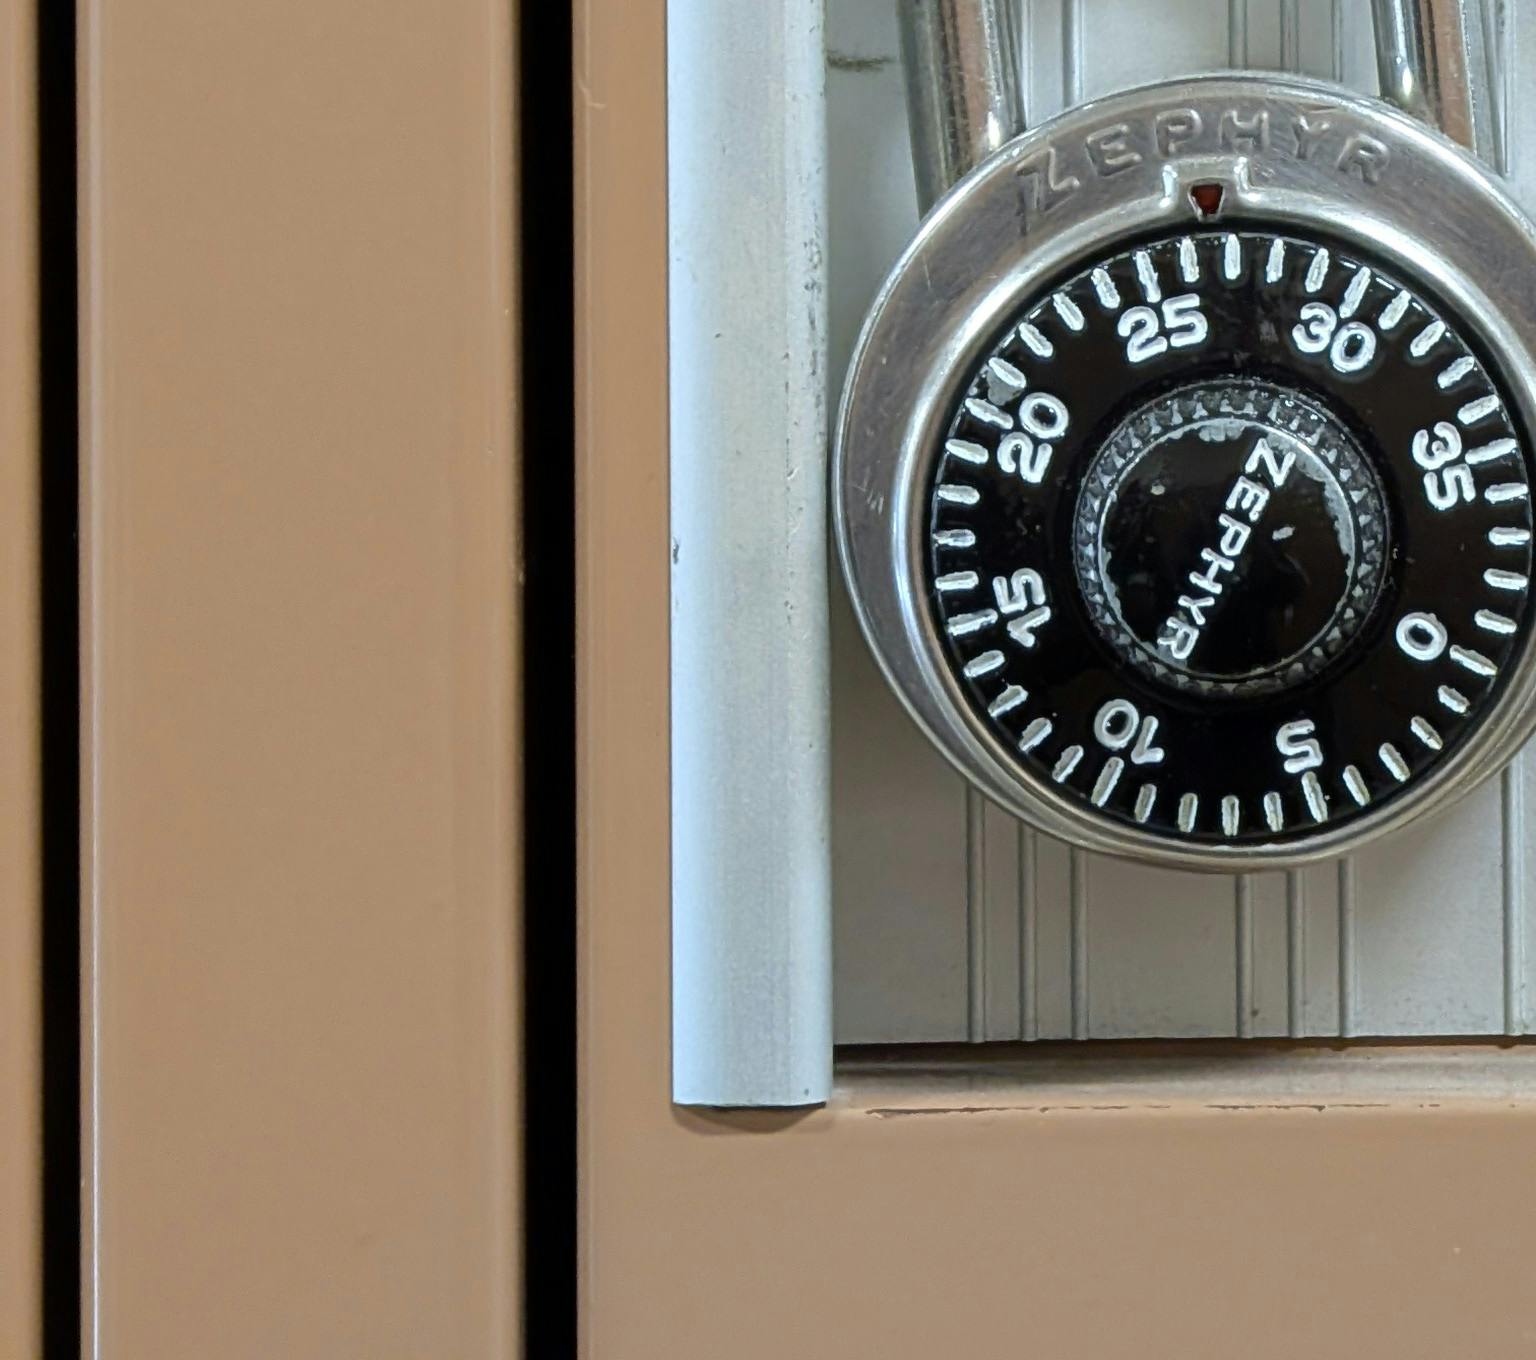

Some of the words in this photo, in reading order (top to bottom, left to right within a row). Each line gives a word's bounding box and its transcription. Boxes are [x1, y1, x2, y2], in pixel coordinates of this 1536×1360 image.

[1020, 109, 1390, 212] ZEPHYR
[1117, 293, 1208, 363] 25
[1293, 302, 1378, 373] 30
[997, 392, 1070, 484] 20
[1412, 421, 1477, 511] 35
[1156, 438, 1297, 661] ZEPHYR
[992, 566, 1053, 648] 15
[1396, 612, 1449, 661] 0
[1093, 698, 1165, 766] 10
[1275, 720, 1322, 777] 5
